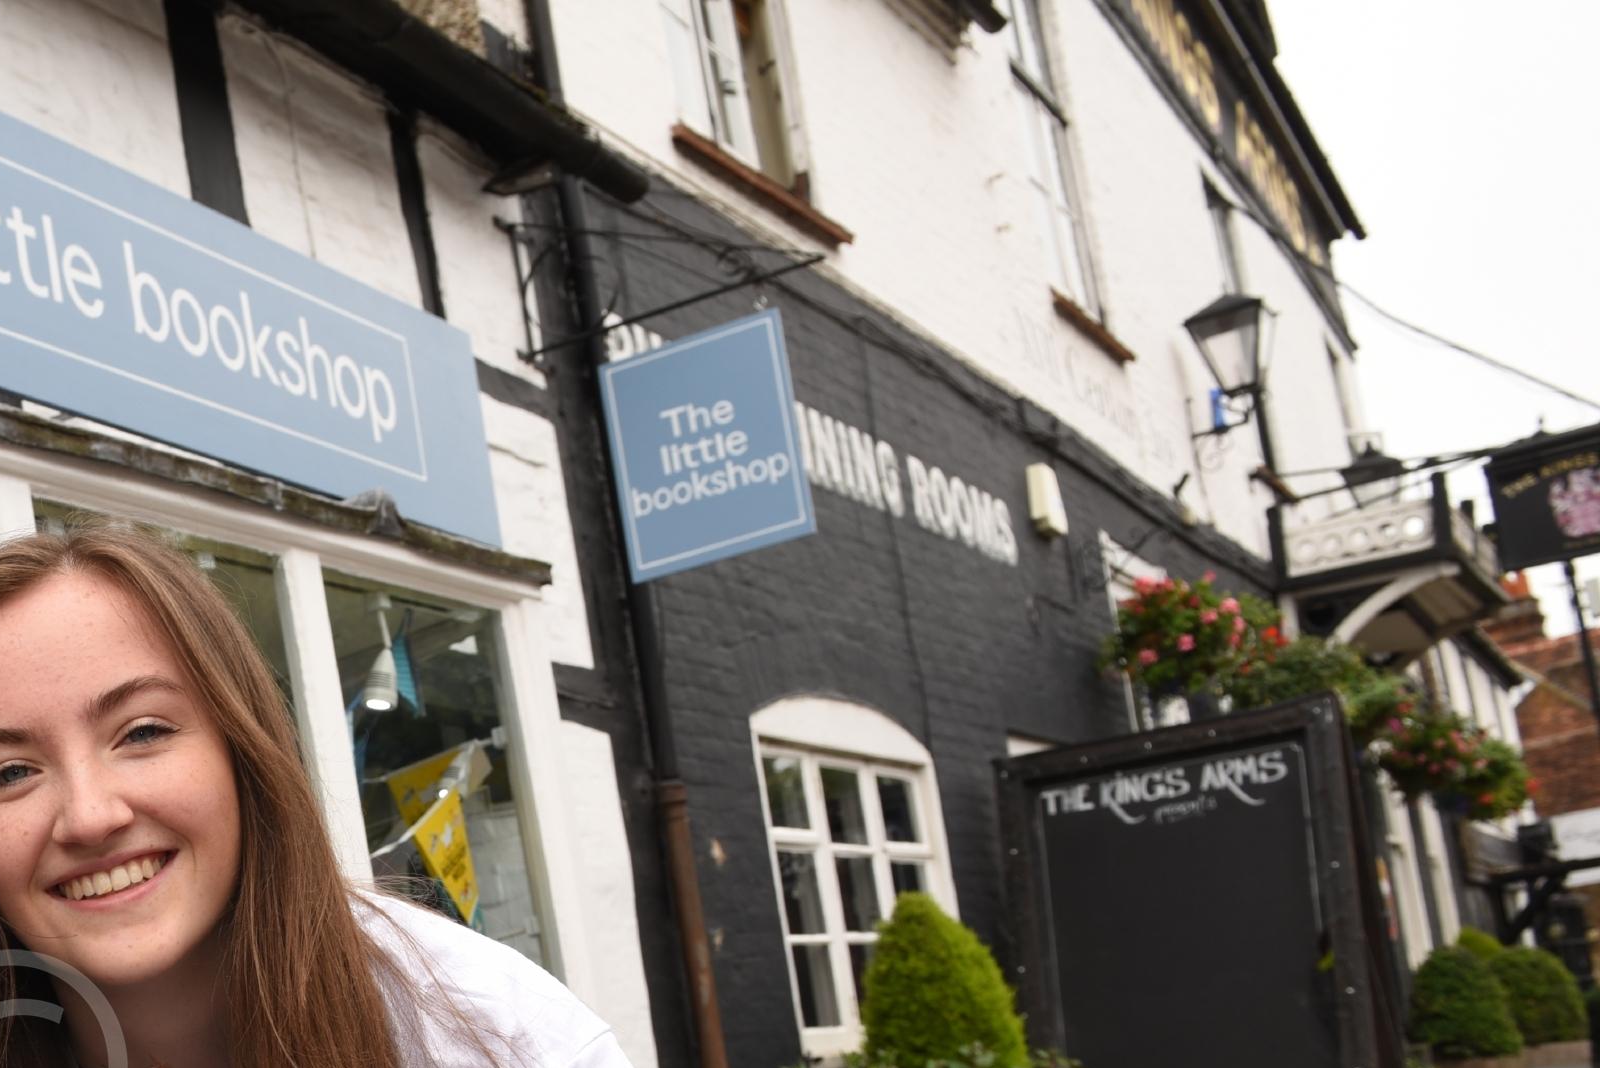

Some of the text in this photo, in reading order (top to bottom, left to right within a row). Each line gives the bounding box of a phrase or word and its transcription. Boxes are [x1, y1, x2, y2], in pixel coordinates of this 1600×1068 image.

[123, 239, 399, 443] bookshop
[660, 400, 735, 438] The
[632, 451, 790, 518] bookshop
[660, 429, 748, 477] little
[906, 454, 1019, 567] ROOMS
[1039, 783, 1095, 816] THE
[1201, 750, 1289, 806] ARMS
